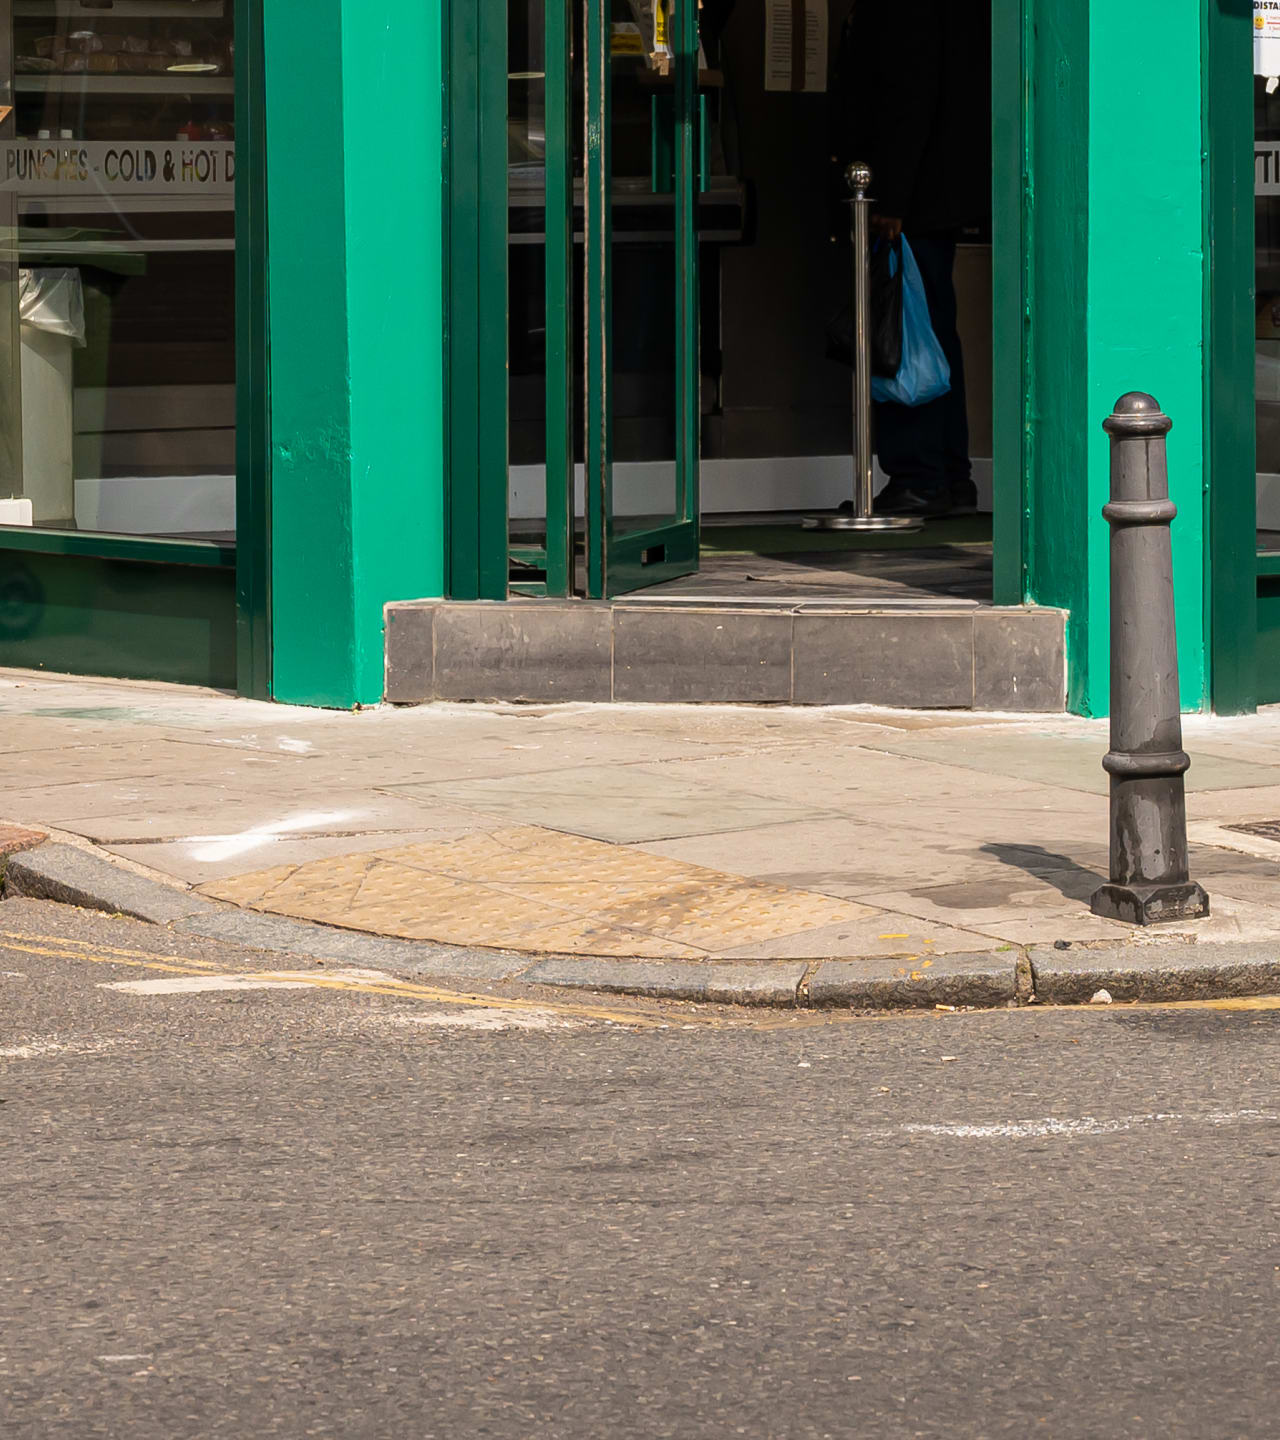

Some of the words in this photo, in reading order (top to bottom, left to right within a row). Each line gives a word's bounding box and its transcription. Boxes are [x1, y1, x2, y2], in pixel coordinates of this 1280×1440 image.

[7, 148, 88, 180] PUNCHES
[105, 149, 157, 181] COLD
[163, 150, 176, 181] &
[182, 150, 219, 182] HOT
